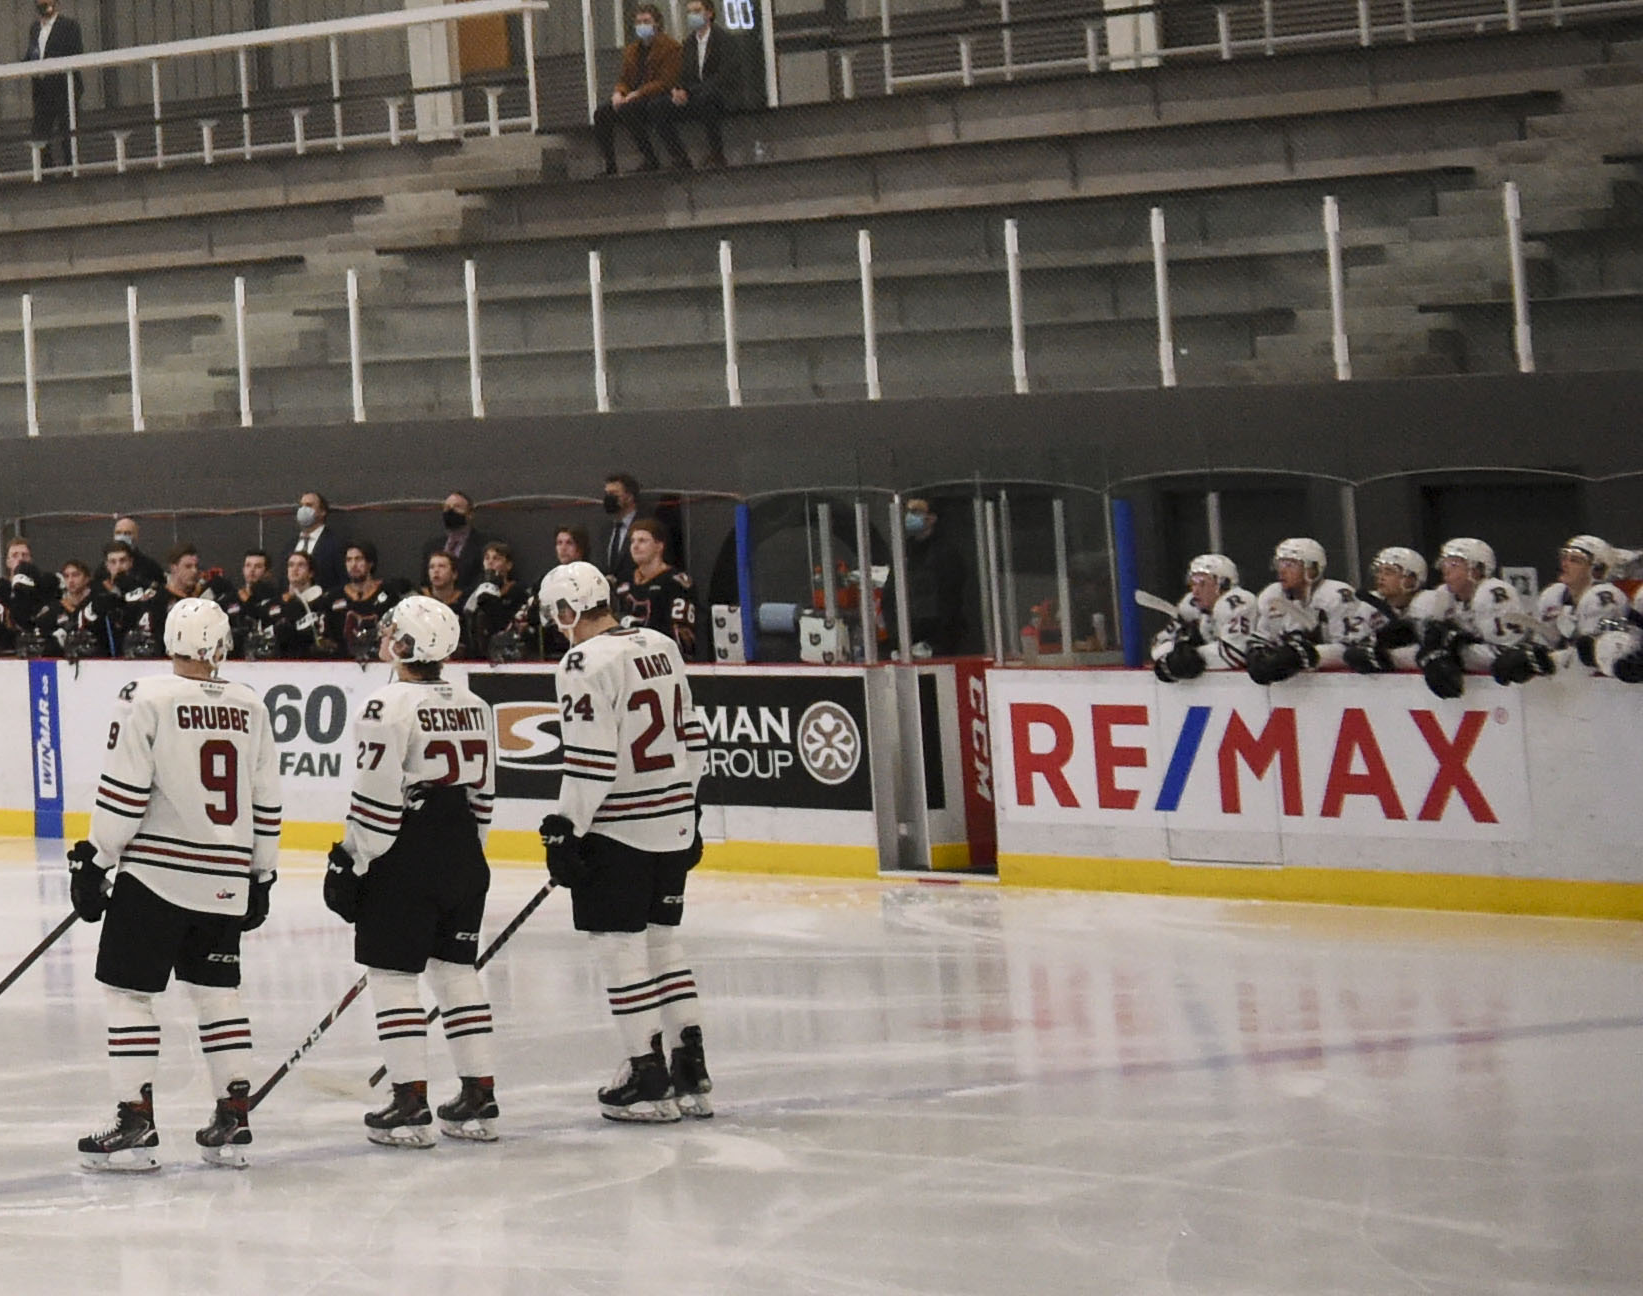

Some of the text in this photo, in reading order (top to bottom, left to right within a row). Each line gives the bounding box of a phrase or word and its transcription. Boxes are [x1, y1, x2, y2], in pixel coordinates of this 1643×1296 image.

[565, 651, 584, 672] R
[633, 653, 672, 680] WARD
[119, 681, 139, 702] R
[176, 704, 250, 734] GRUBBE
[363, 699, 384, 721] R
[561, 693, 594, 722] 24
[107, 721, 120, 750] 9
[969, 675, 992, 802] CCM
[279, 752, 341, 777] FAN
[356, 741, 386, 771] 27
[424, 739, 488, 789] 27
[1009, 703, 1499, 824] RE/MAX
[199, 738, 239, 826] 9
